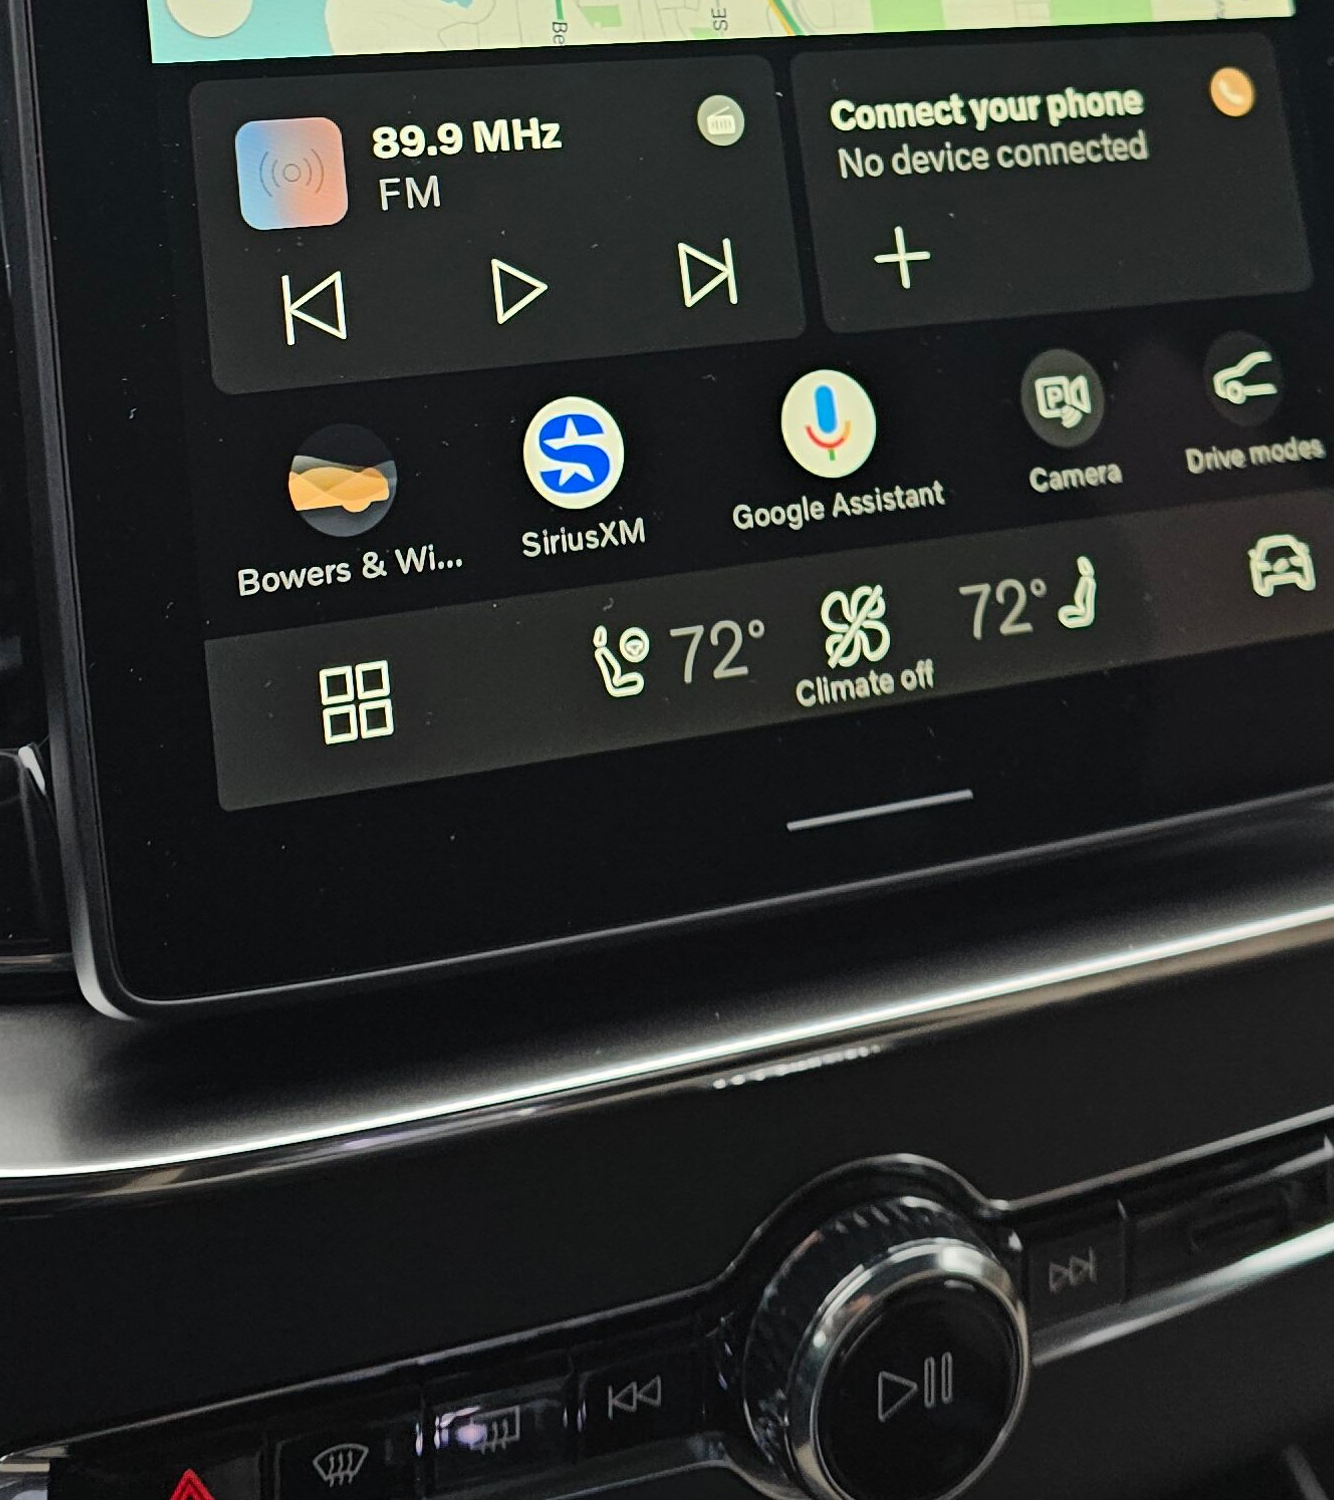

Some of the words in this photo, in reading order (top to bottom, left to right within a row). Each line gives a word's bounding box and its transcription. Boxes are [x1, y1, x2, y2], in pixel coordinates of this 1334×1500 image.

[711, 8, 728, 31] SE
[830, 93, 967, 132] Connect
[968, 95, 1042, 131] your
[1046, 87, 1145, 127] phone
[372, 123, 463, 160] 89.9
[473, 117, 563, 154] MHz
[838, 147, 884, 179] No
[891, 141, 990, 175] device
[997, 128, 1150, 169] connected
[379, 175, 441, 211] FM
[1185, 445, 1246, 475] Drive
[1249, 435, 1326, 469] modes
[1029, 462, 1123, 494] Camera
[733, 495, 826, 532] Google
[832, 480, 946, 519] Assistant
[522, 517, 646, 559] SiriusXM
[237, 558, 351, 597] Bowers
[361, 551, 388, 579] &
[395, 544, 463, 574] Wi...
[959, 578, 1047, 639] 72°
[669, 619, 765, 684] 72°
[795, 669, 895, 708] Climate
[900, 658, 935, 691] off
